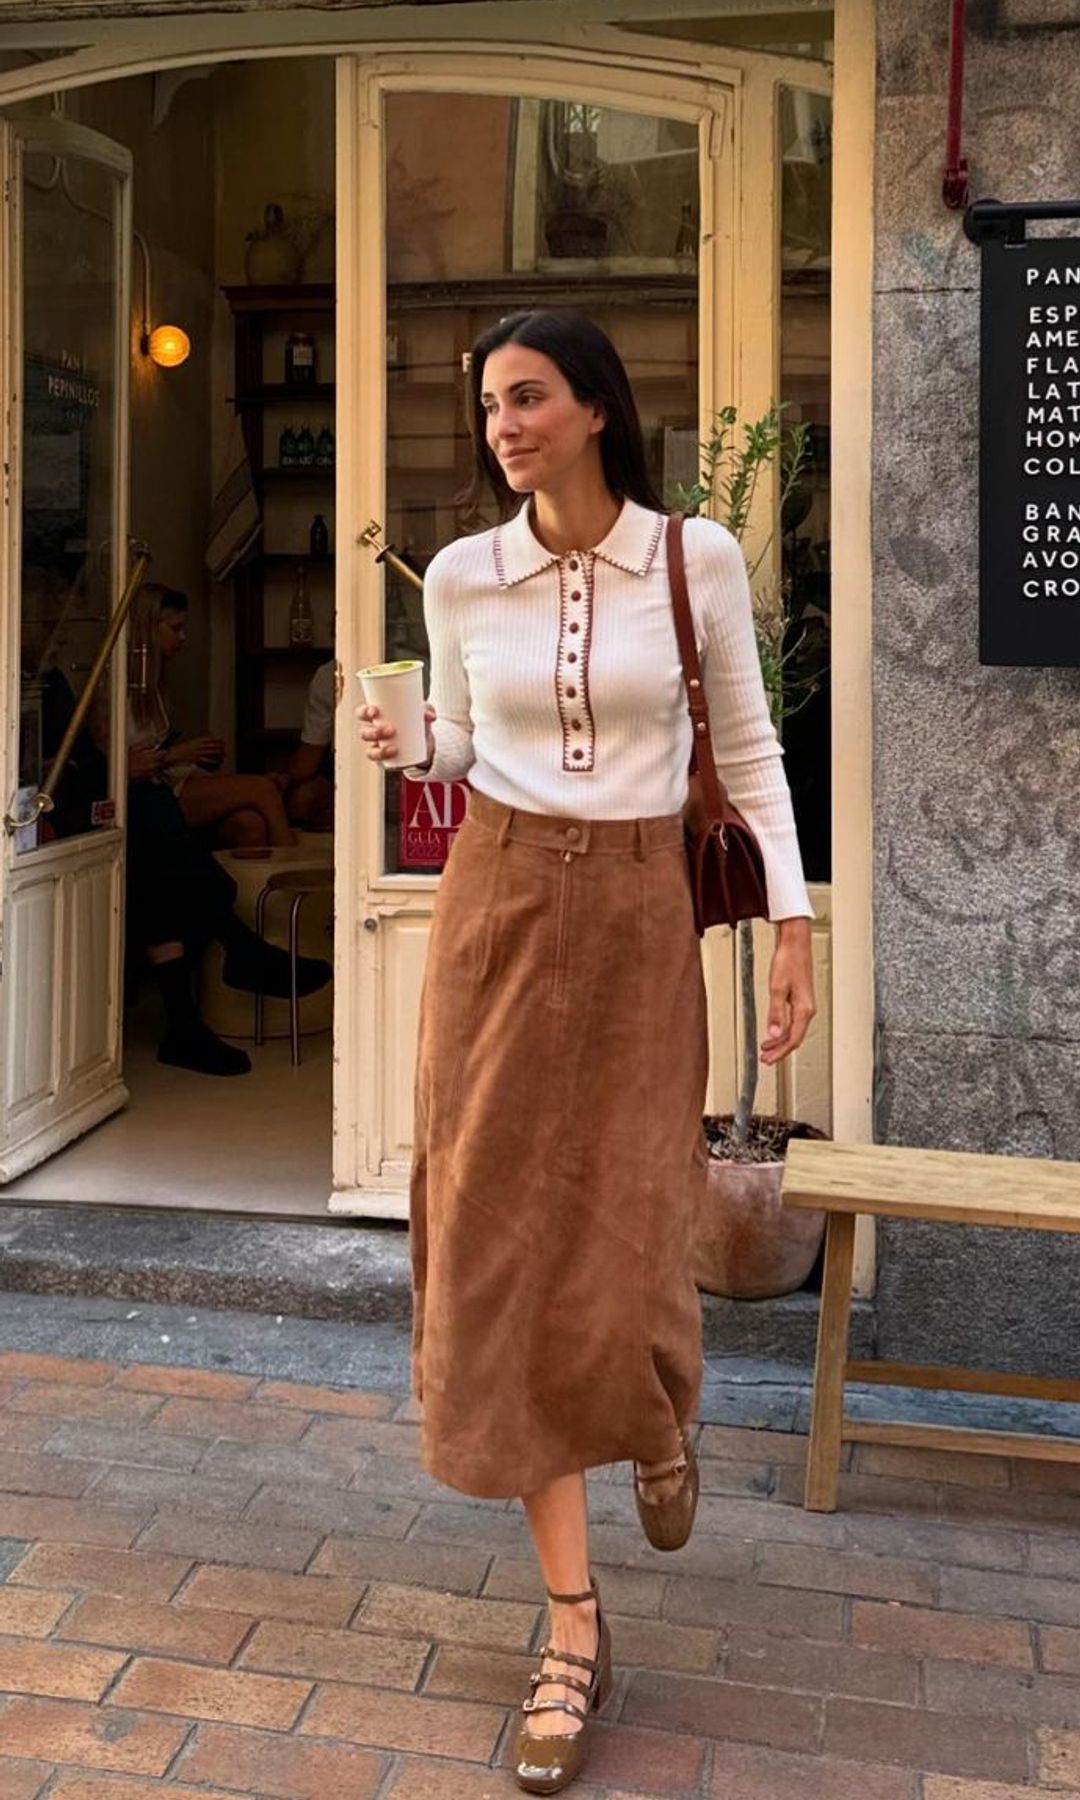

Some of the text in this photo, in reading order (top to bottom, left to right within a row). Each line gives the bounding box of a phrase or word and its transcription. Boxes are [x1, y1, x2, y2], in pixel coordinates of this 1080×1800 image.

[1026, 266, 1080, 286] PAN
[1029, 303, 1078, 325] ESP
[1026, 328, 1080, 349] AME
[1026, 355, 1079, 375] FLA
[1028, 381, 1080, 400] LAT
[1027, 405, 1080, 425] MAT
[1026, 430, 1080, 448] HOM
[1023, 457, 1080, 476] COL
[1025, 501, 1080, 521] BAN
[1022, 525, 1080, 544] GRA
[1022, 550, 1080, 569] AVO
[1022, 578, 1080, 598] CRO
[408, 781, 472, 829] AD
